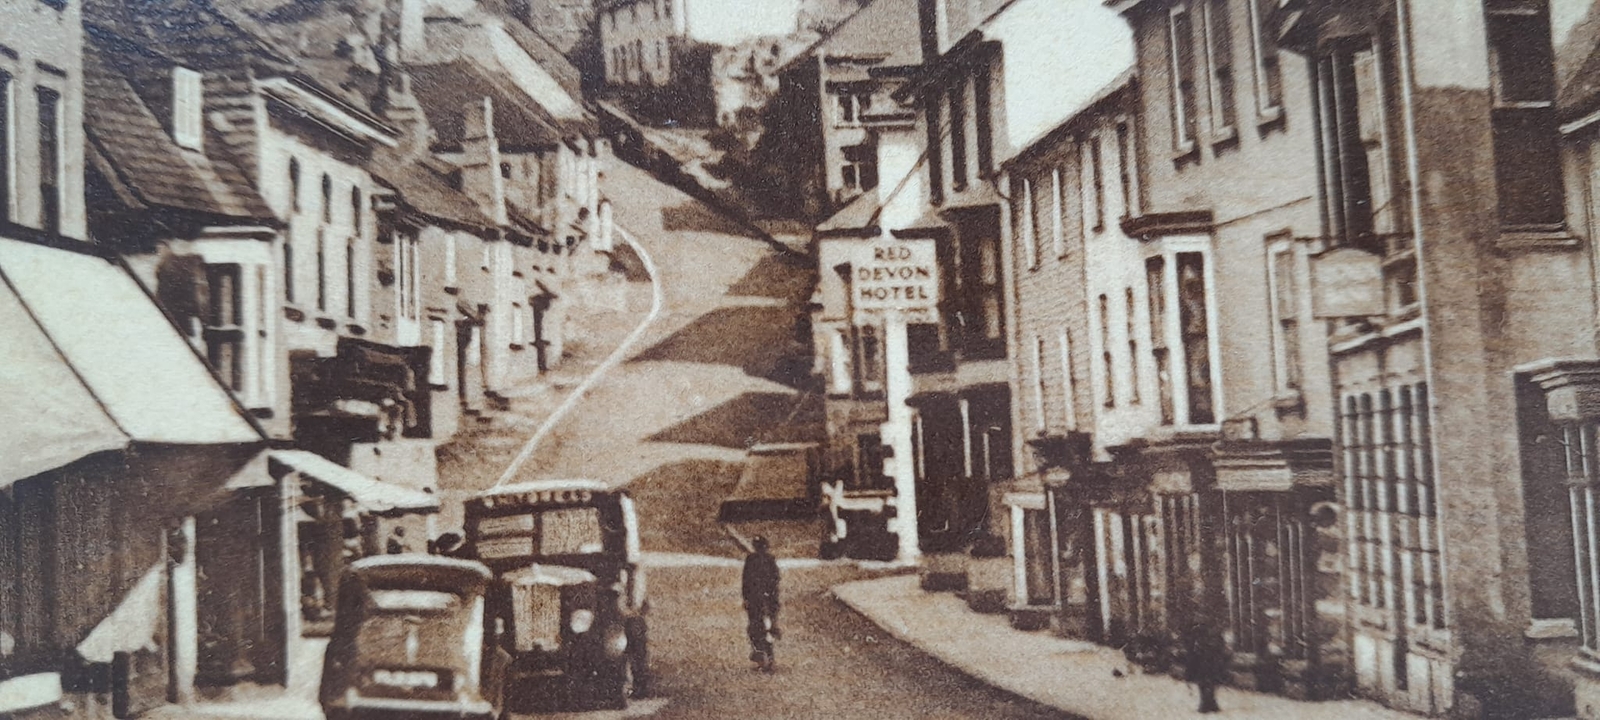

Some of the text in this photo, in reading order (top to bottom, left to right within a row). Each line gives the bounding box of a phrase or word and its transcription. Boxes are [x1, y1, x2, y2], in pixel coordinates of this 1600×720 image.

[874, 246, 911, 261] RED
[858, 266, 931, 281] DEVON
[860, 286, 928, 300] HOTEL
